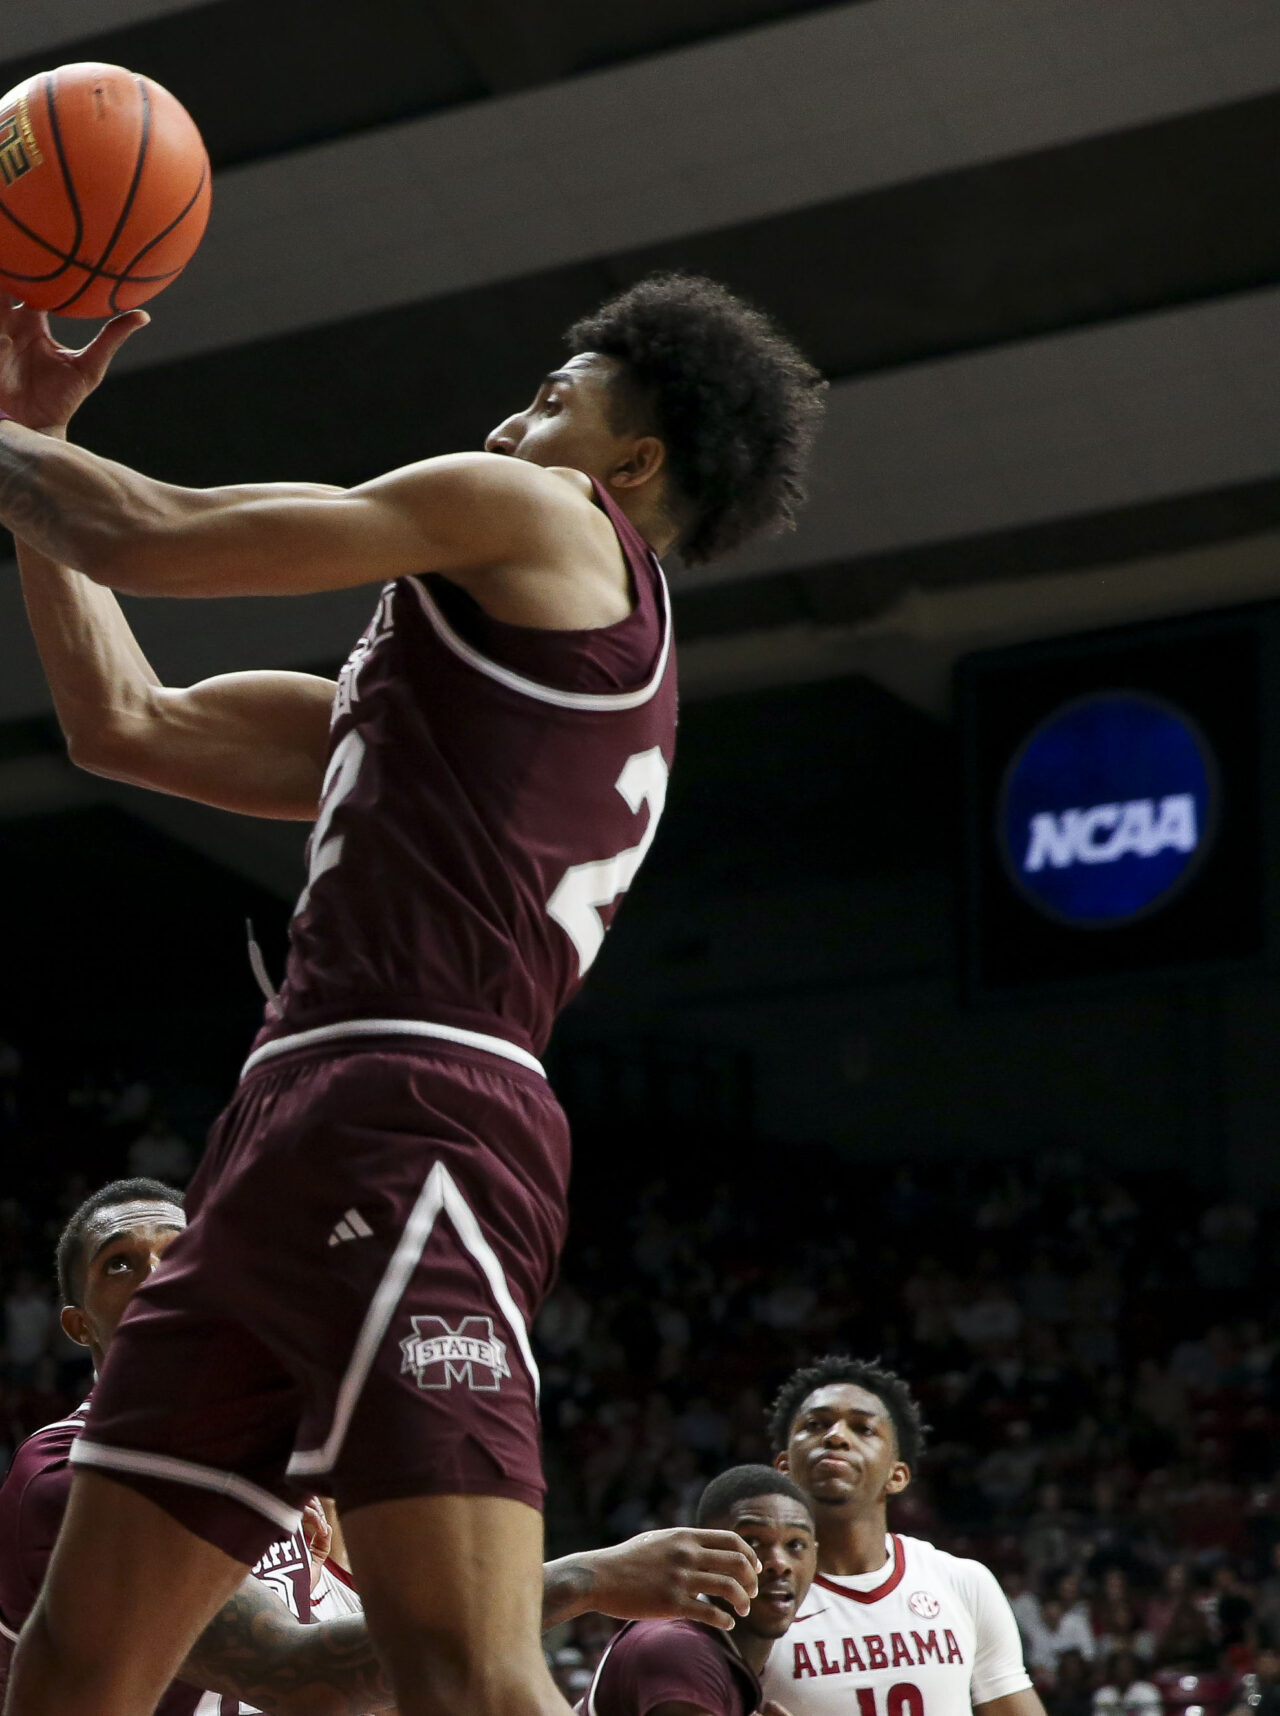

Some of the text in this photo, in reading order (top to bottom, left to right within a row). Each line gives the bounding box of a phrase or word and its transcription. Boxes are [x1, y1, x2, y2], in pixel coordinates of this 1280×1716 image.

[1024, 793, 1196, 872] NCAA
[422, 1337, 489, 1362] STATE
[793, 1628, 964, 1680] ALABAMA
